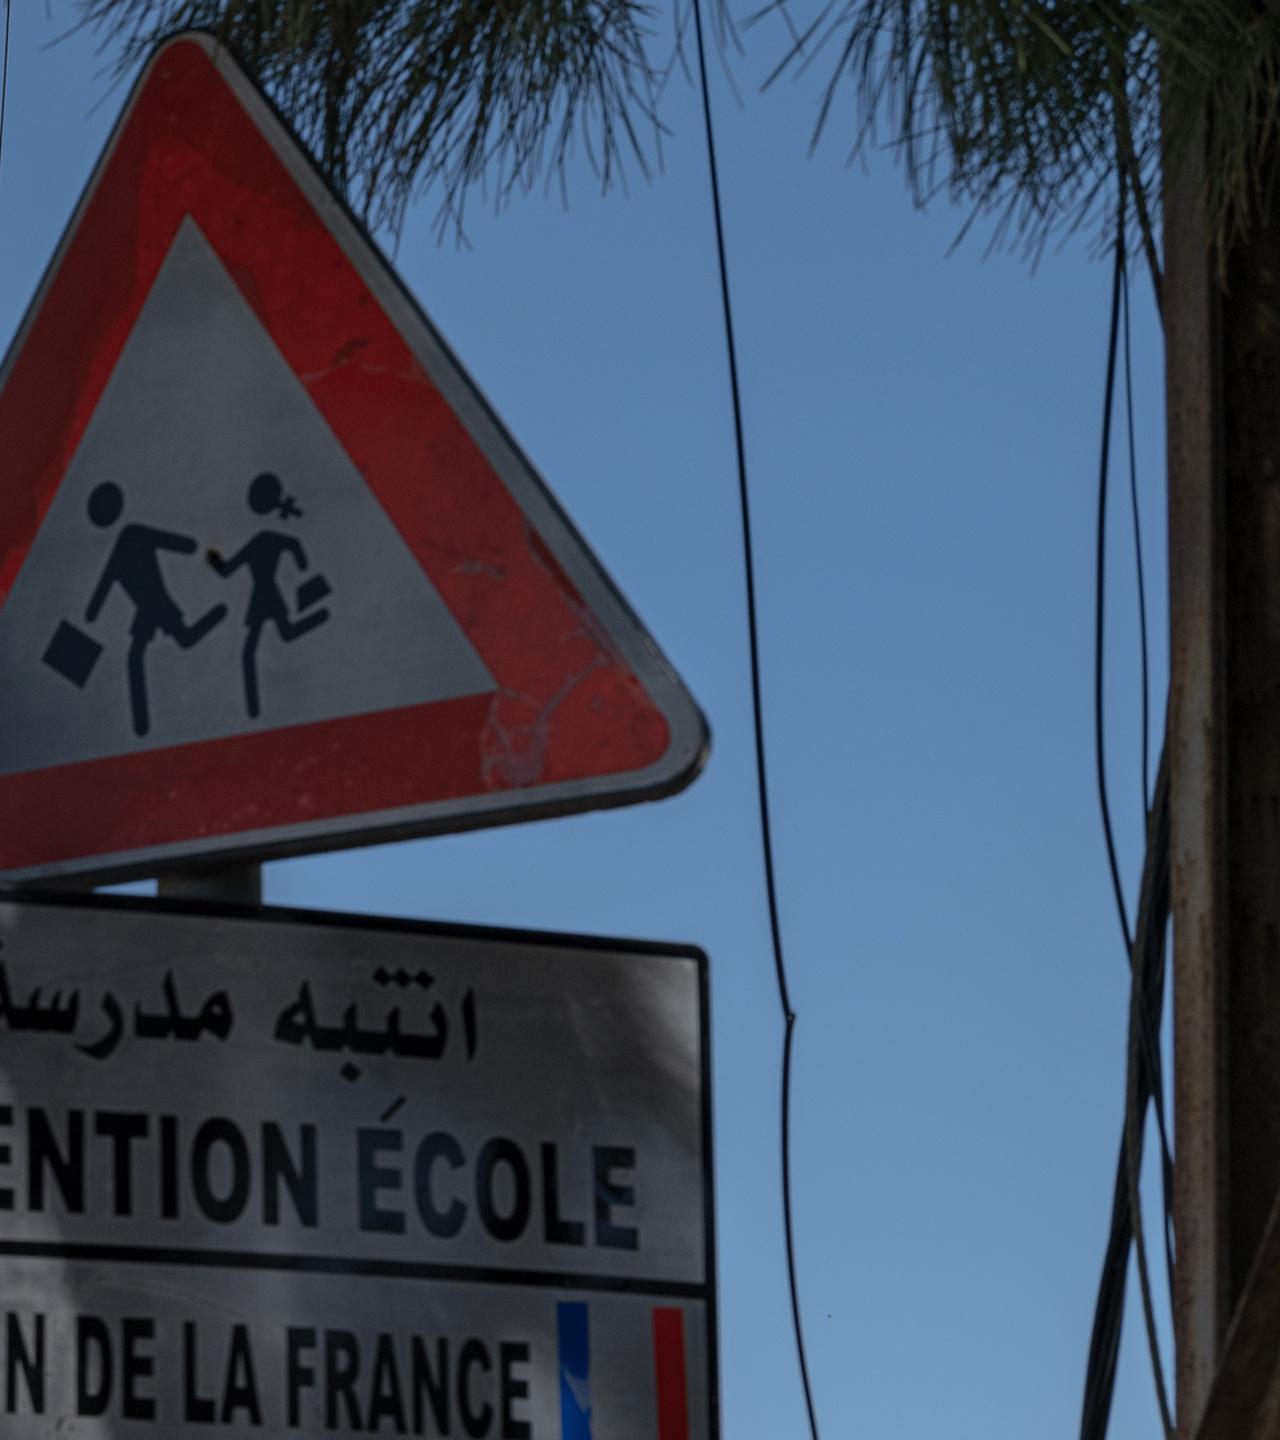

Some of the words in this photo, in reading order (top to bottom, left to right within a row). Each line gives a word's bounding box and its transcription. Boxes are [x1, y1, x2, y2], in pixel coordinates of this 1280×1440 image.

[272, 964, 479, 1084] انتبه
[355, 1095, 640, 1253] ÉCOLE
[75, 1313, 158, 1424] DE
[181, 1319, 265, 1428] LA
